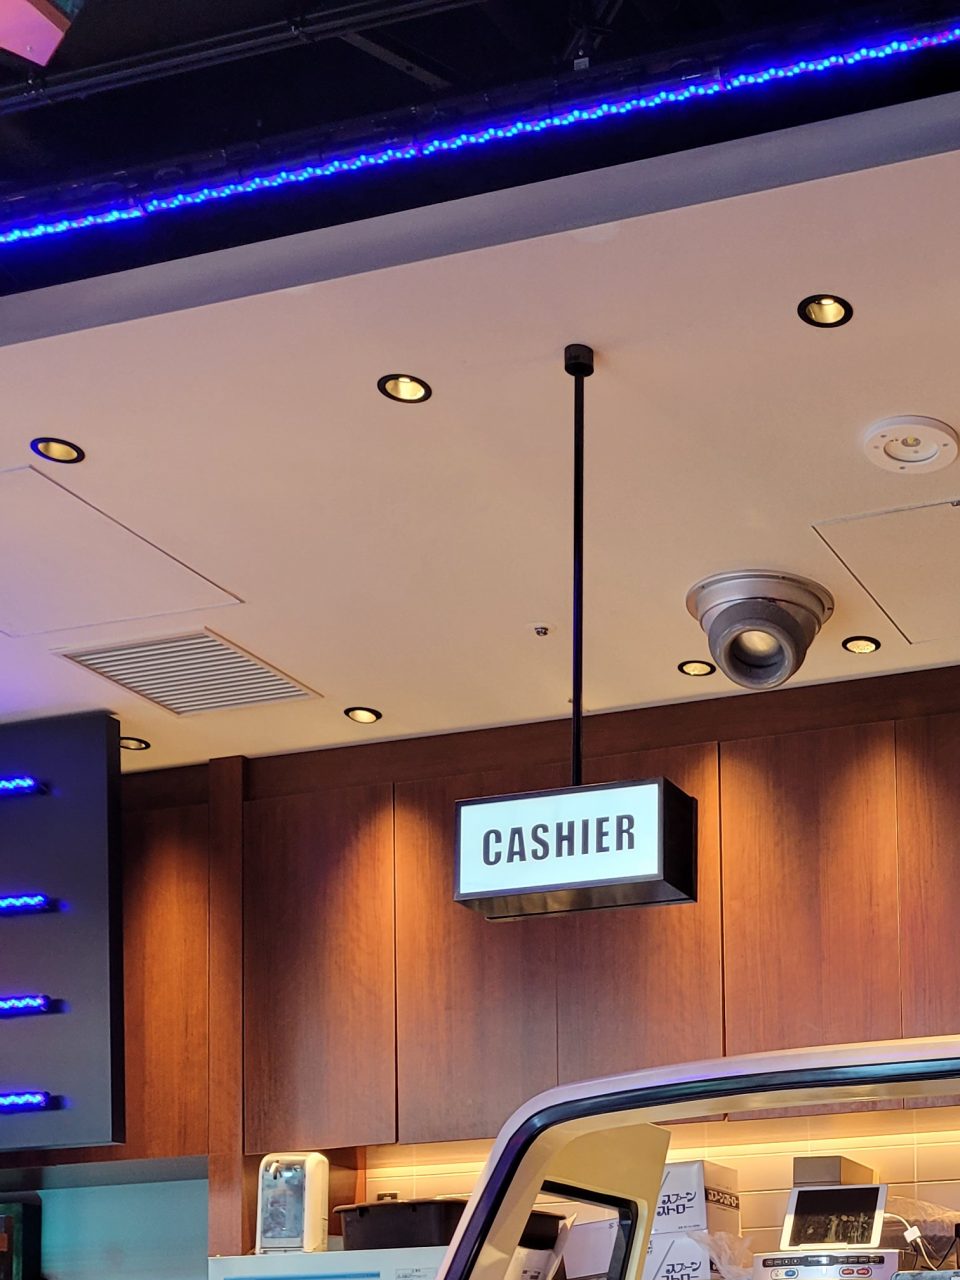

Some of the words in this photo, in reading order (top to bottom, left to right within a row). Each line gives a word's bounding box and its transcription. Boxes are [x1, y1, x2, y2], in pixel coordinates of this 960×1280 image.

[482, 813, 636, 866] CASHIER
[662, 1191, 697, 1206] スプーン
[656, 1204, 694, 1217] ストロー
[665, 1261, 702, 1274] スプーン
